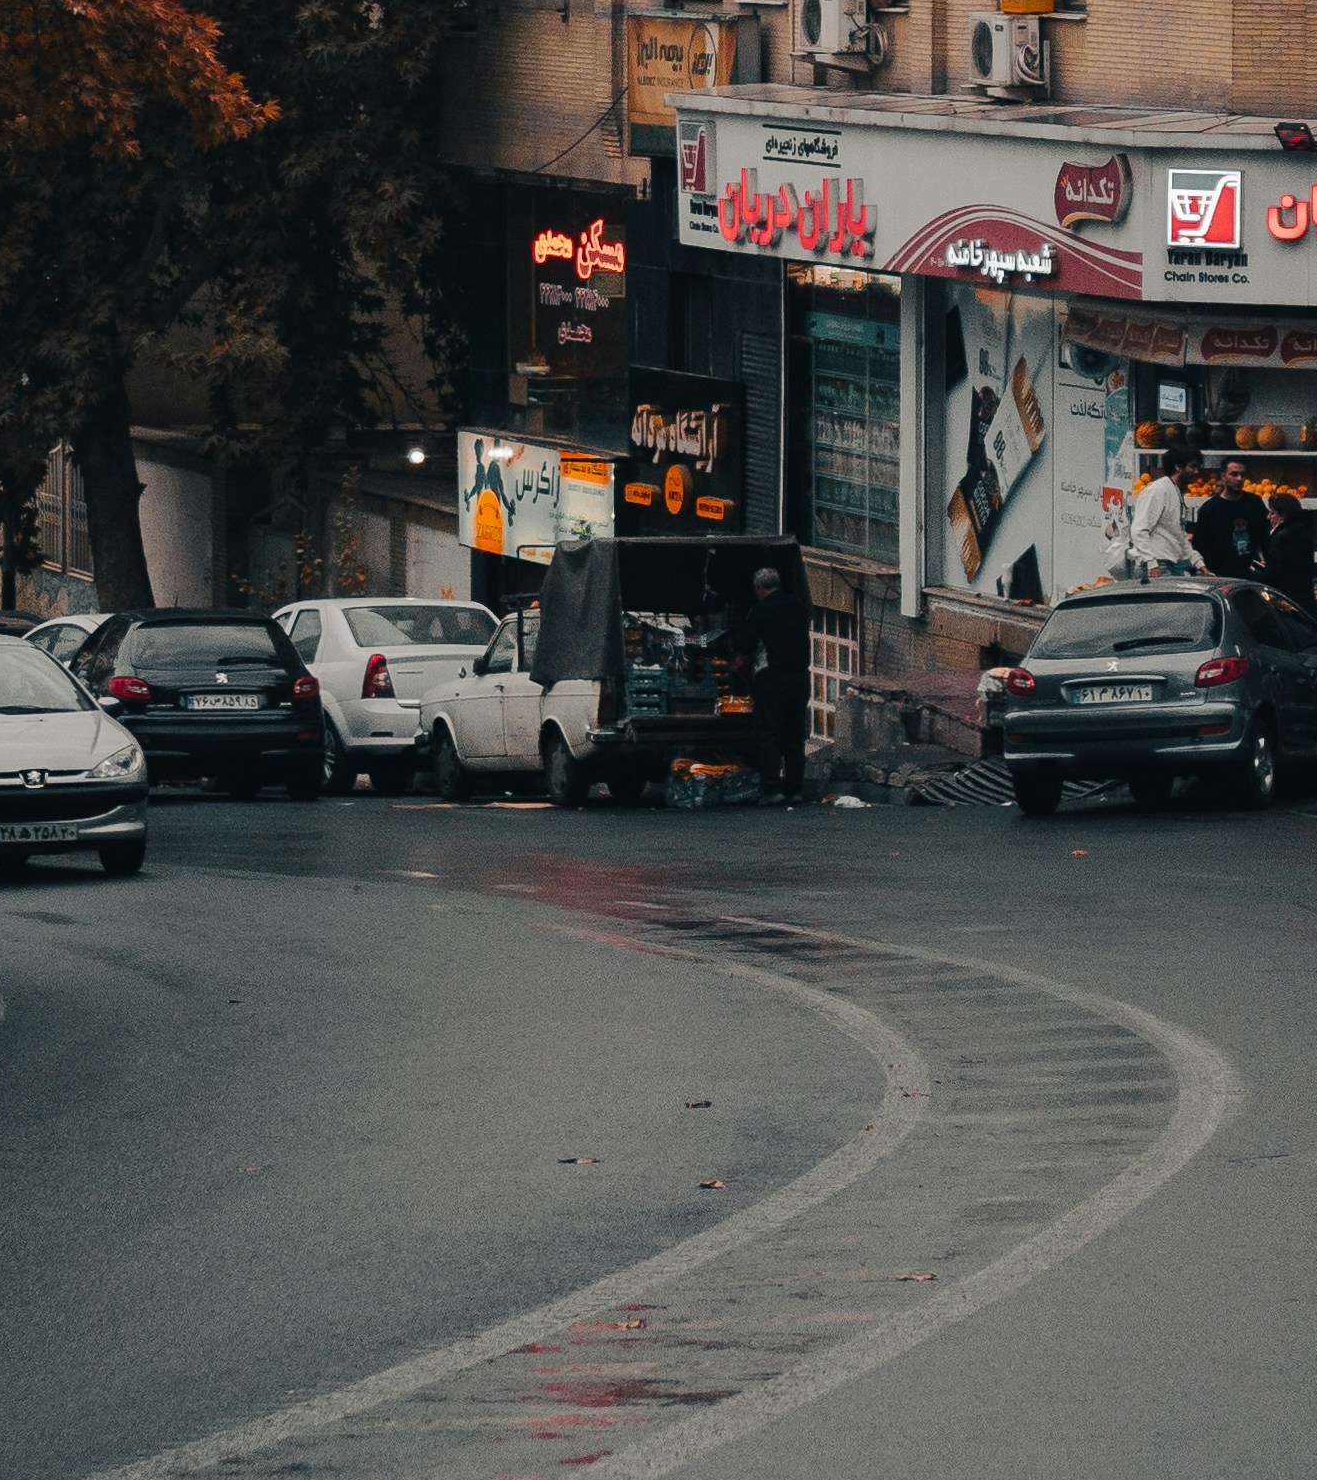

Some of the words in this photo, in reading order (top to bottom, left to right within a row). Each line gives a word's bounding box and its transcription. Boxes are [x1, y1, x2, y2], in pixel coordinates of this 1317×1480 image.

[718, 167, 792, 246] دریان
[1066, 176, 1115, 205] تکدانه
[797, 177, 867, 257] یاران
[578, 220, 624, 279] مسکن
[947, 239, 983, 267] خامنه
[981, 249, 1017, 283] سپهر
[1017, 243, 1052, 281] شعبه
[1164, 271, 1195, 282] Chain
[1199, 272, 1229, 283] Stores
[1232, 273, 1250, 284] Co.
[1213, 336, 1270, 350] تکدانه
[516, 461, 561, 508] زاگرس
